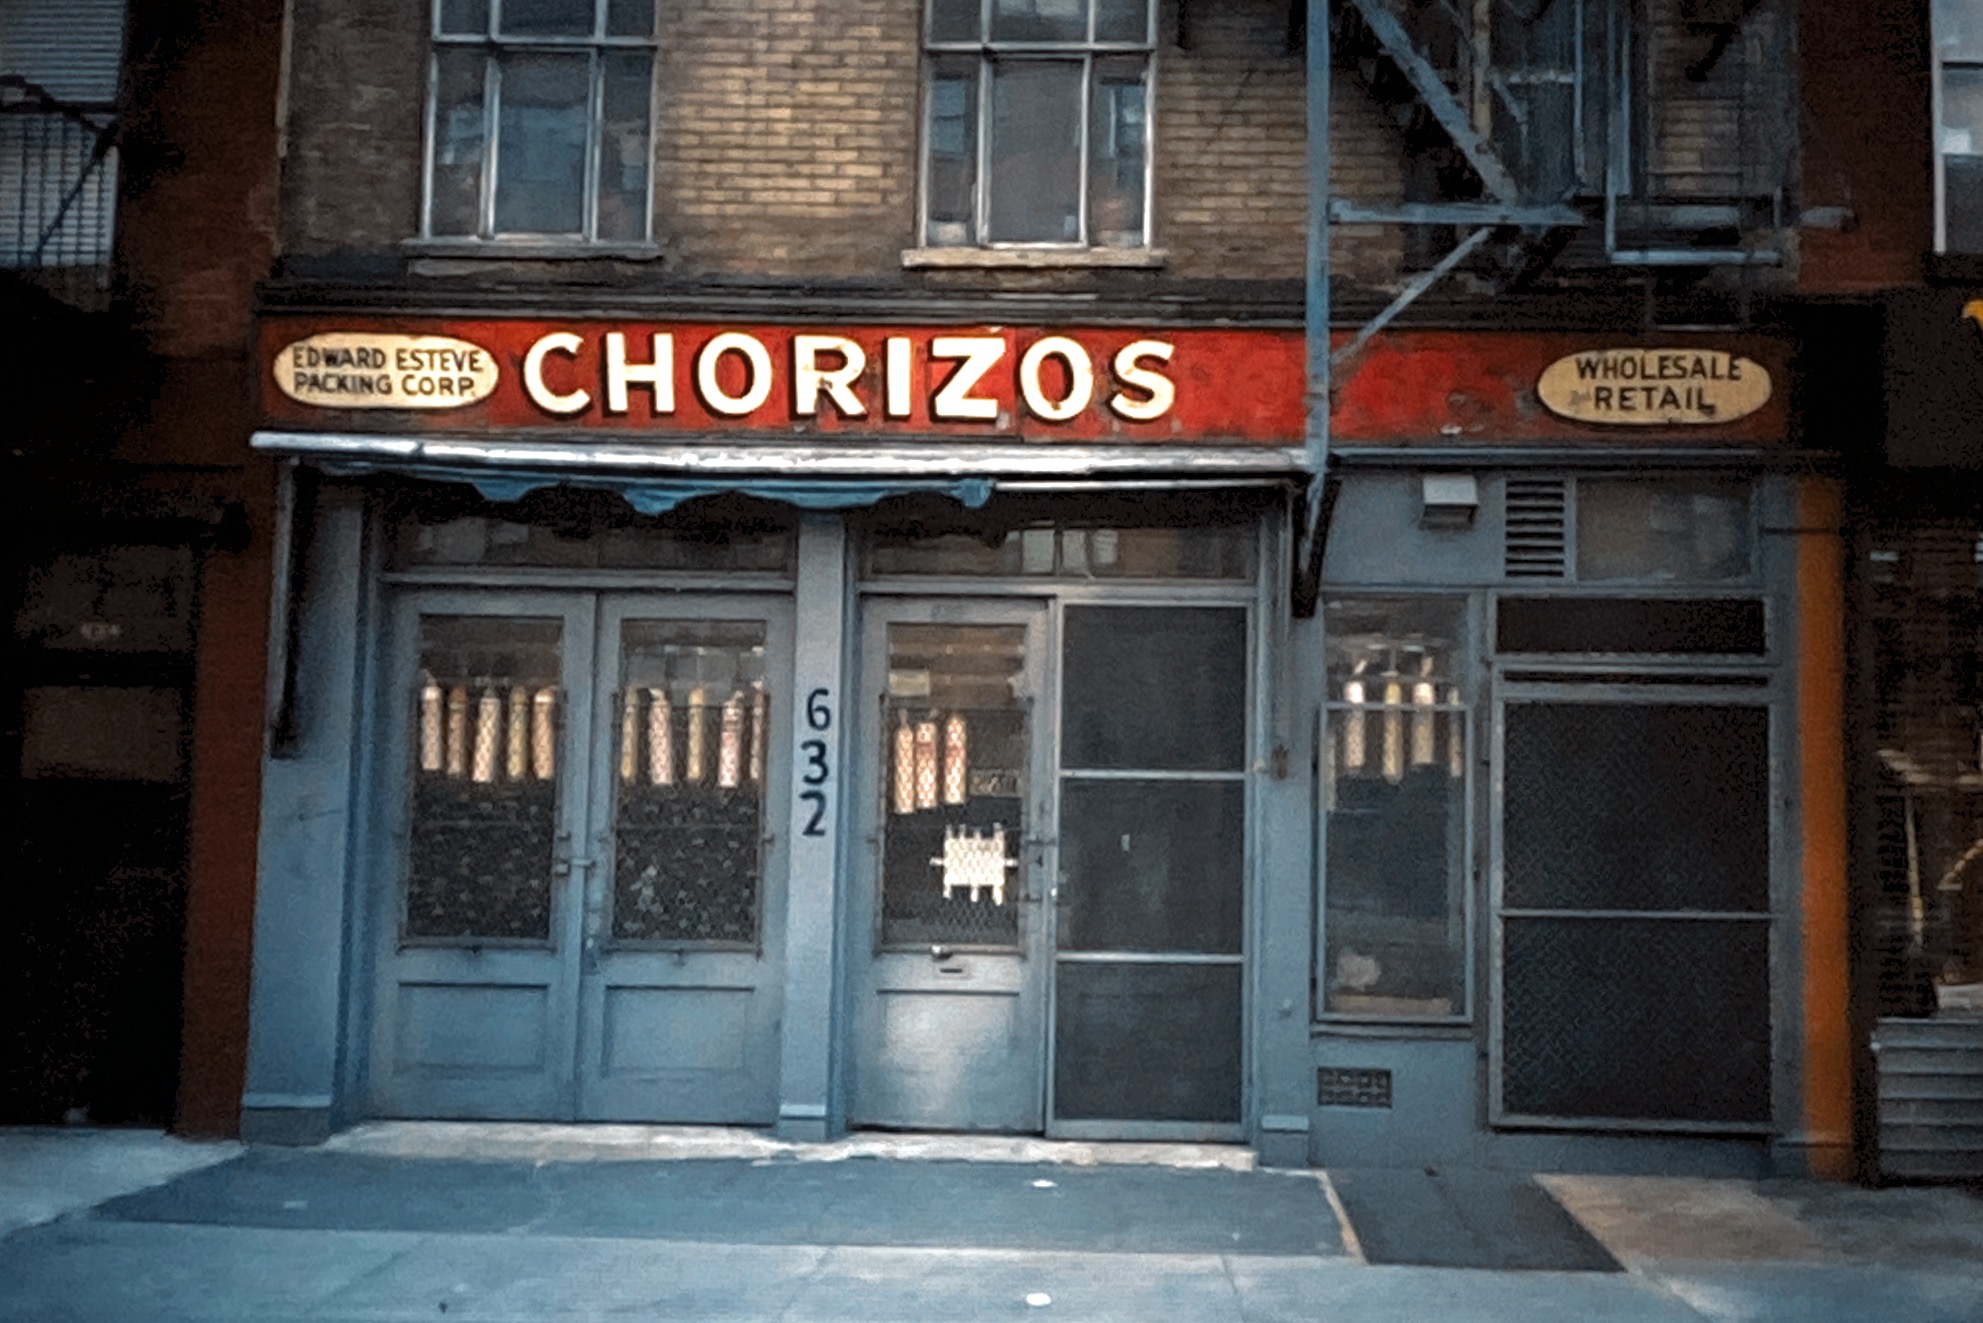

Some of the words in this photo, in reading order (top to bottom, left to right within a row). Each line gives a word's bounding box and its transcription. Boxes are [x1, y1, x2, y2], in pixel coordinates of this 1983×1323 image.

[293, 346, 386, 368] EDWARD
[396, 348, 484, 372] ESTEVE
[1575, 355, 1742, 380] WHOLESALE
[294, 372, 393, 395] PACKING
[523, 332, 1176, 421] CHORIZOS
[1594, 386, 1716, 415] RETAIL
